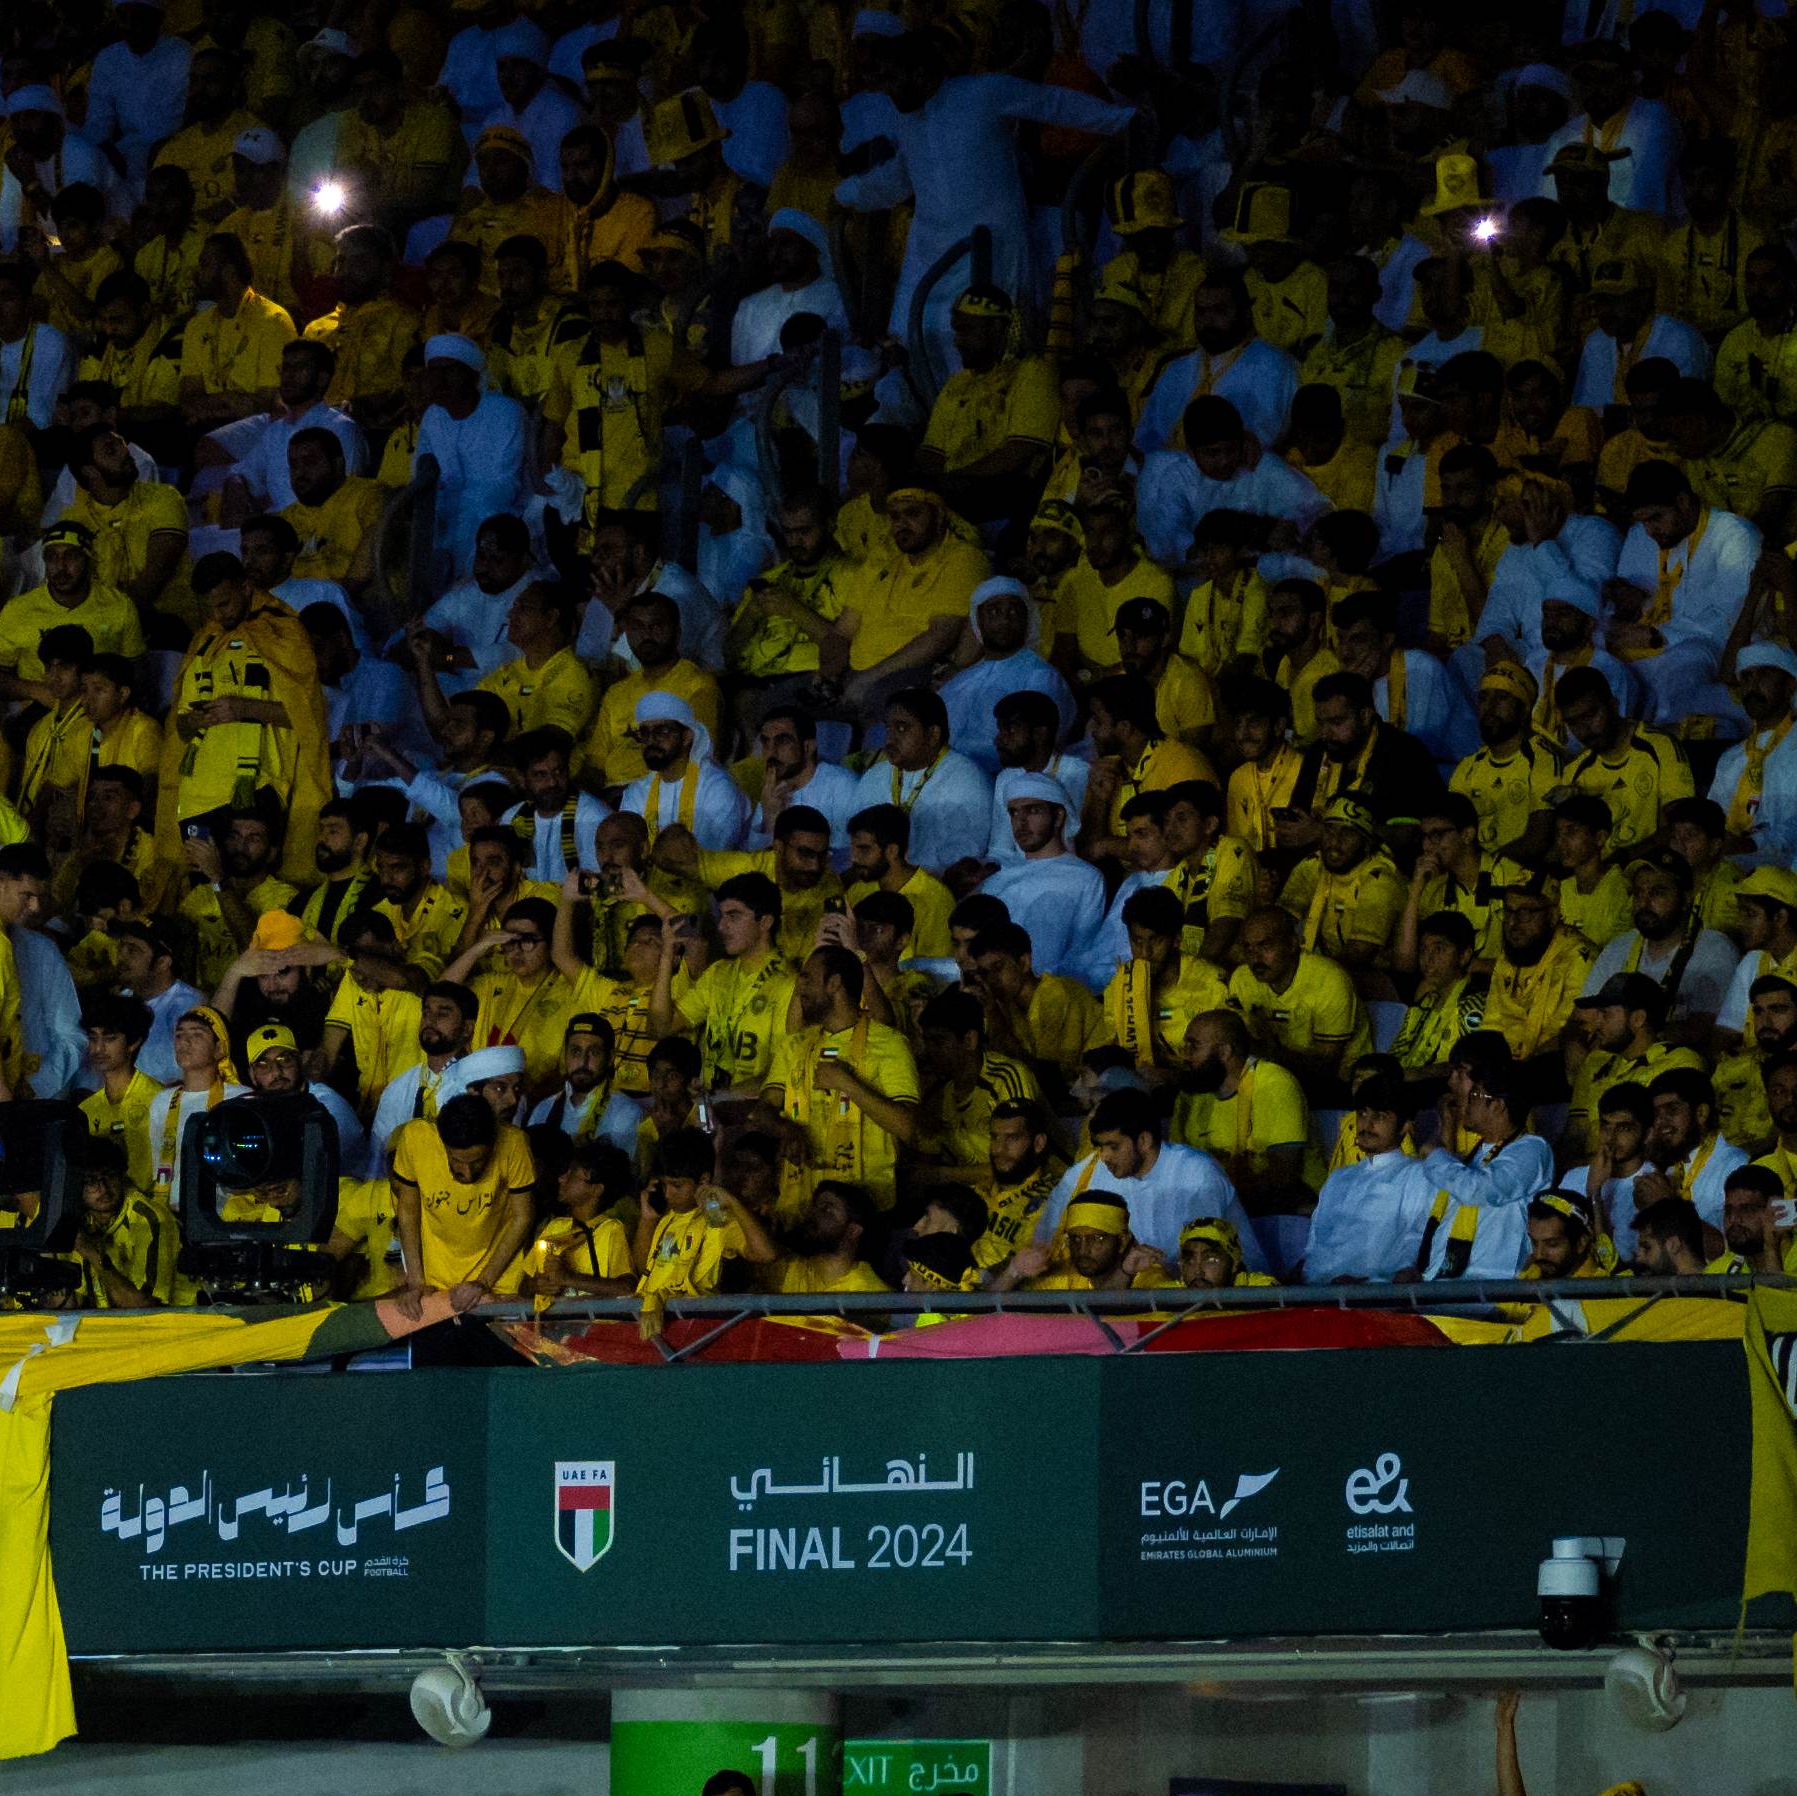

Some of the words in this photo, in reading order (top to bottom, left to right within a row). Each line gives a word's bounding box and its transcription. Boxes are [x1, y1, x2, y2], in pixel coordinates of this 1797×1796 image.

[562, 1470, 587, 1481] UAE
[592, 1469, 608, 1480] FA
[729, 1451, 975, 1512] النهائي
[100, 1468, 213, 1554] الدولة
[217, 1473, 332, 1542] رئيس
[335, 1465, 451, 1547] كأس
[1140, 1480, 1217, 1517] EGA
[728, 1527, 856, 1572] FINAL
[866, 1523, 974, 1569] 2024
[1346, 1523, 1390, 1540] etisalat
[1392, 1522, 1415, 1538] and
[139, 1563, 179, 1582] THE
[184, 1560, 312, 1580] PRESIDENT'S
[317, 1558, 358, 1578] CUP
[1140, 1549, 1187, 1561] EMIRATES
[1188, 1548, 1224, 1560] GLOBAL
[1225, 1546, 1278, 1558] ALUMINIUM
[363, 1567, 410, 1578] FOOTBALL
[848, 1756, 892, 1786] XIT
[908, 1756, 979, 1792] مخرج
